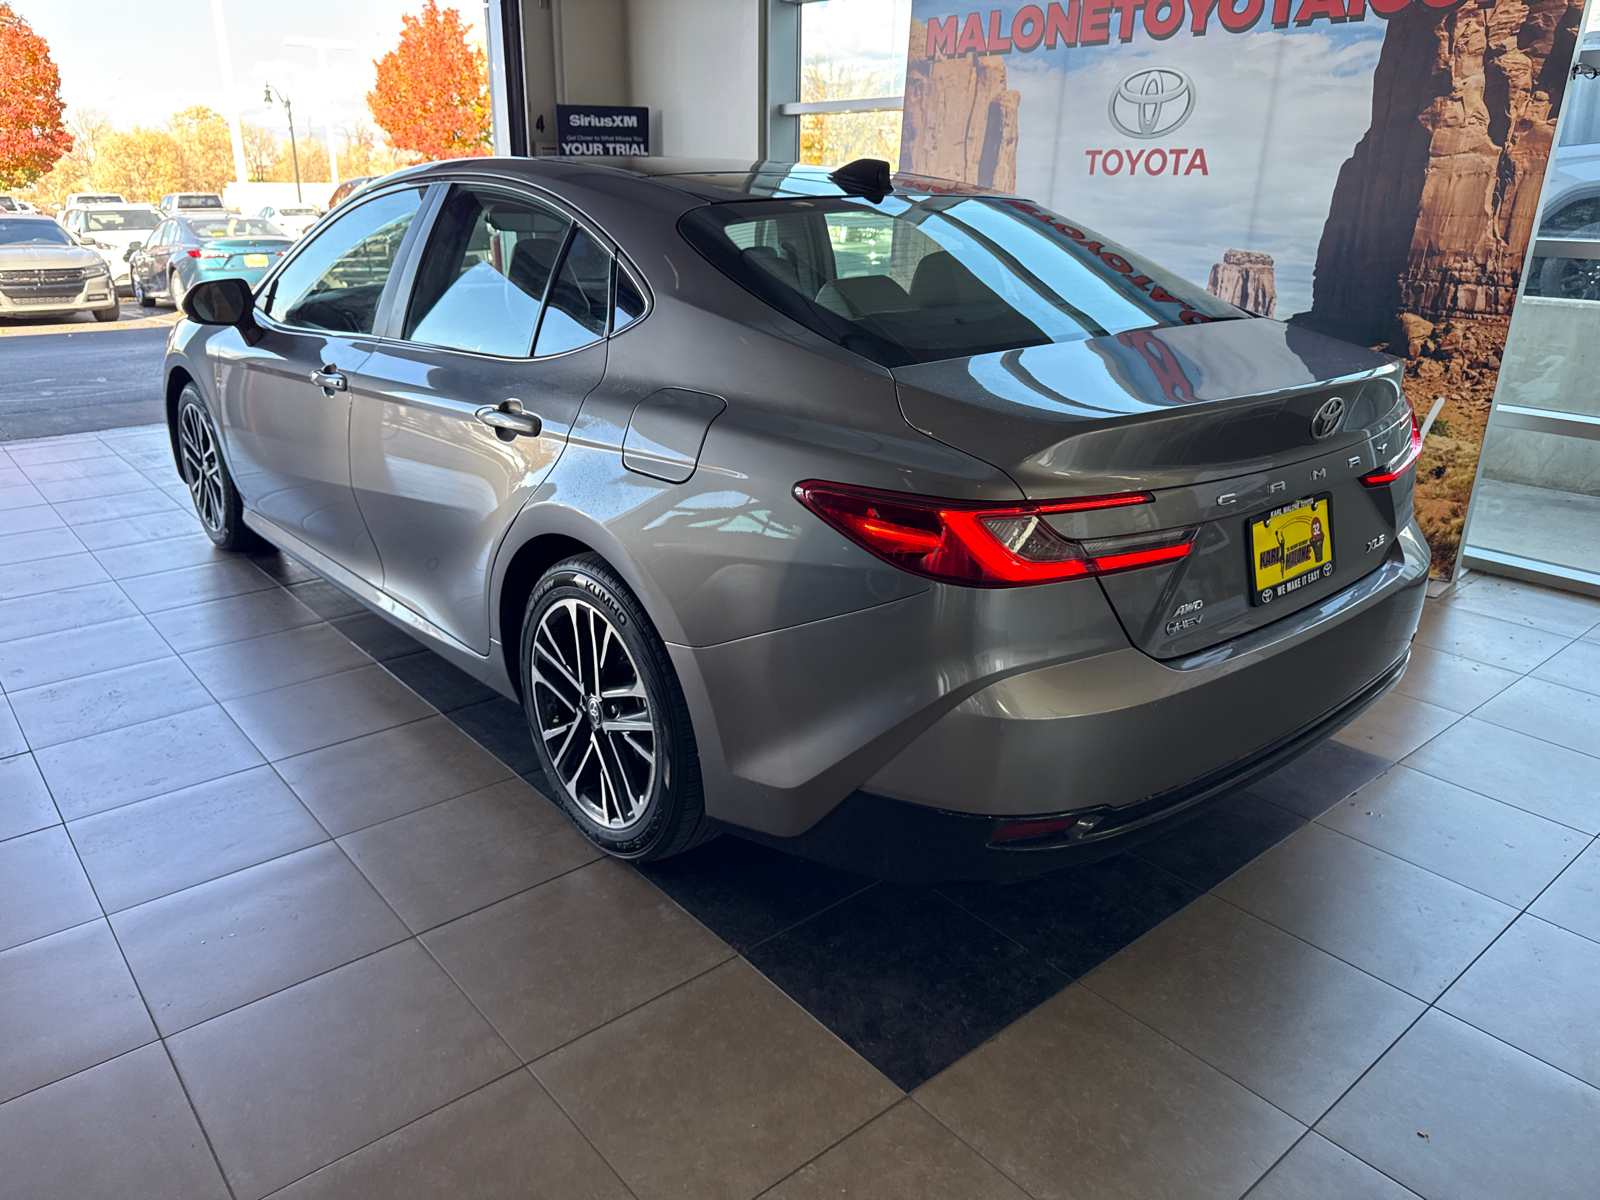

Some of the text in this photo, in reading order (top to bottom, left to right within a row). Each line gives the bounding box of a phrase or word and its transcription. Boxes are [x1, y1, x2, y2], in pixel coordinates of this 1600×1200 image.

[535, 114, 545, 133] 4
[569, 114, 638, 128] SiriusXM
[562, 143, 603, 155] YOUR
[606, 143, 648, 156] TRIAL
[1085, 148, 1208, 176] TOYOTA
[1216, 443, 1388, 506] CAMRY
[1270, 507, 1282, 518] KARL
[1313, 523, 1320, 535] 32
[1366, 534, 1385, 553] XLE
[1260, 546, 1281, 570] KARL
[1277, 569, 1320, 597] WE MAKE IT EASY
[585, 580, 627, 627] KUMHO
[1173, 599, 1203, 618] AWD
